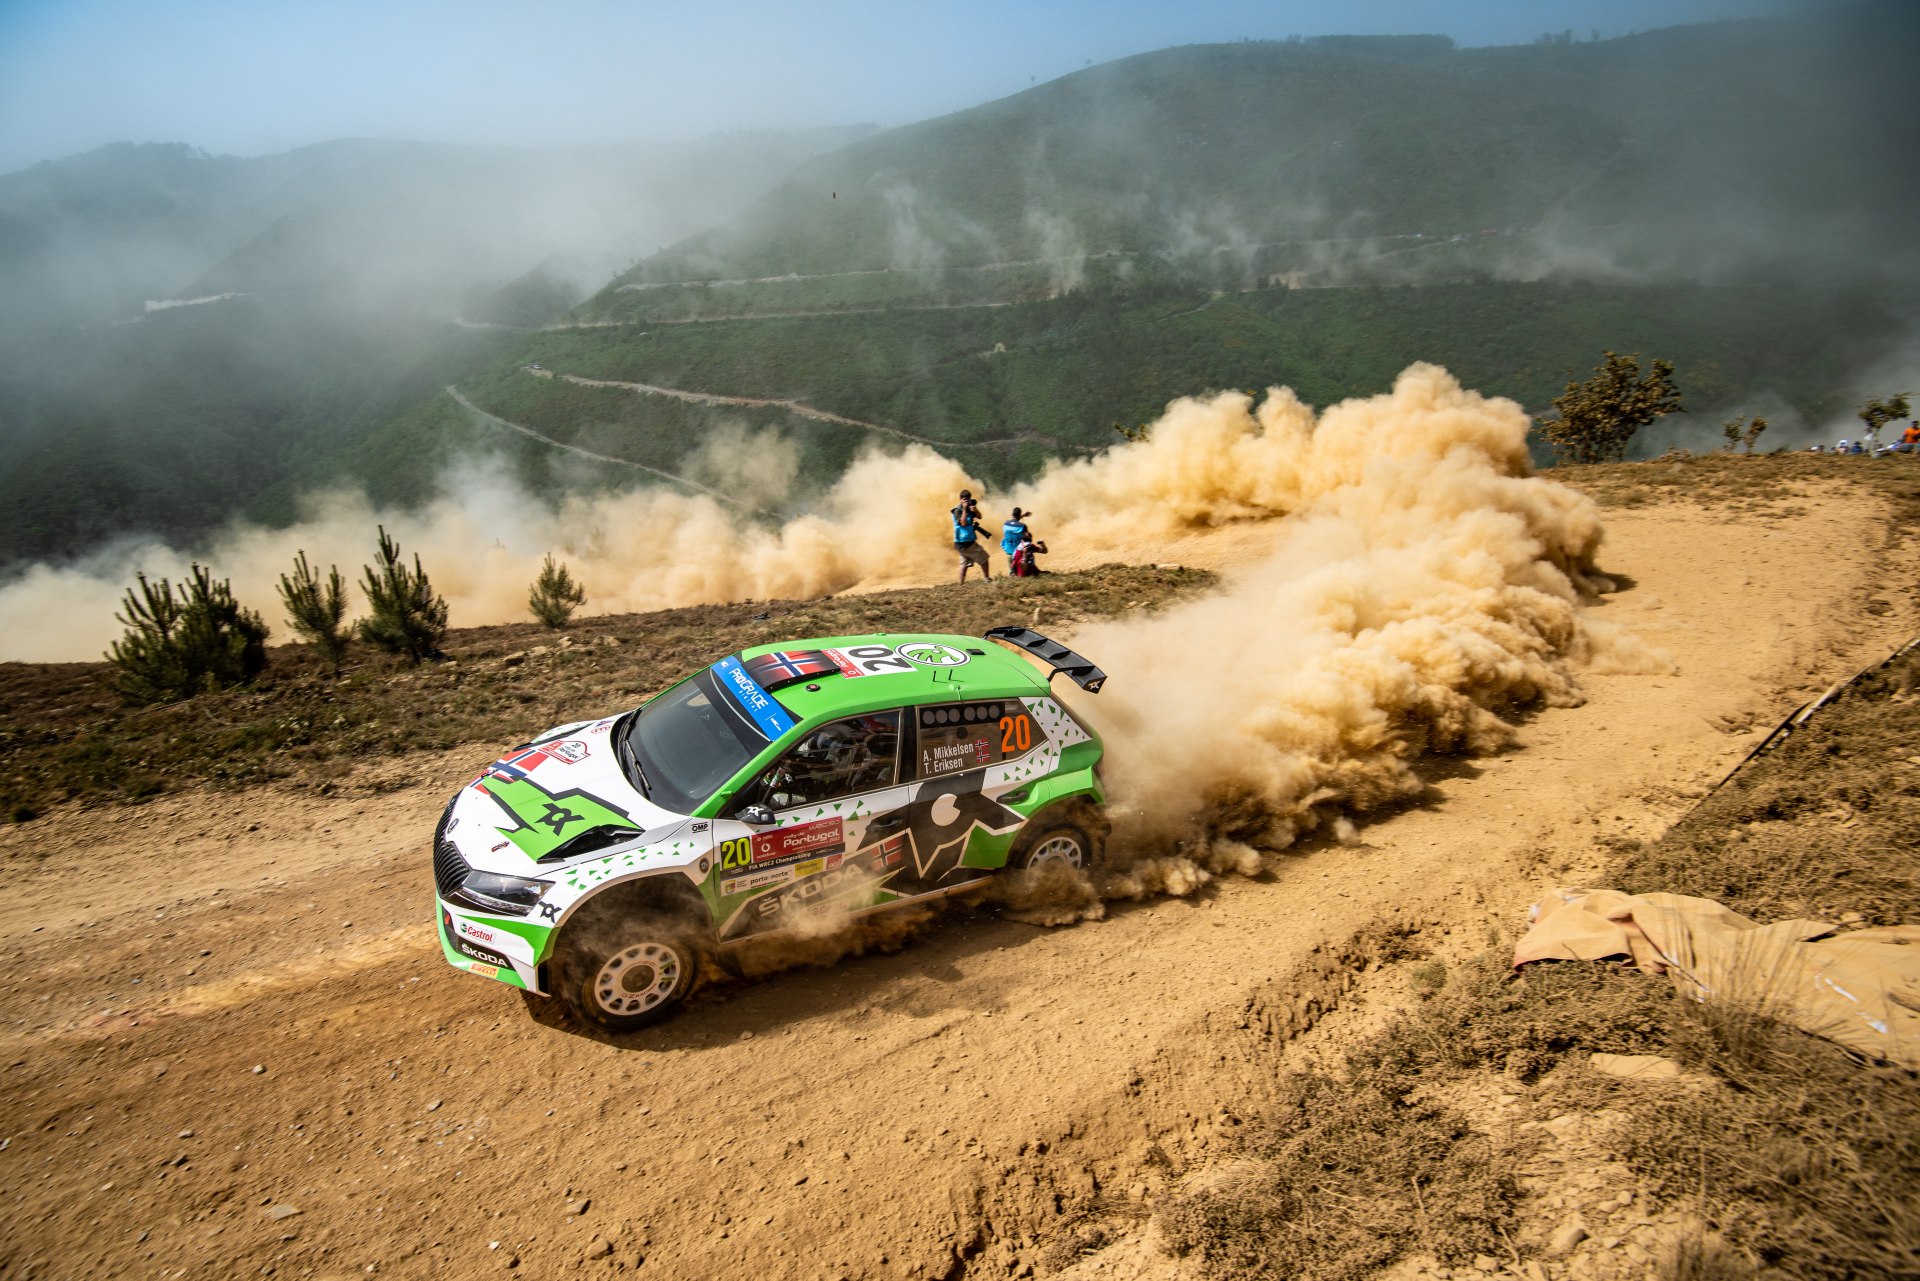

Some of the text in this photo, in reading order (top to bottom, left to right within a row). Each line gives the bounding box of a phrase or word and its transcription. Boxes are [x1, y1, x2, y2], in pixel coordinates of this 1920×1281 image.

[738, 690, 758, 712] DIGITAL
[999, 714, 1031, 753] 20
[923, 743, 974, 762] A. Mikkelsen
[923, 758, 964, 775] T. Eriksen
[691, 823, 708, 832] OMP
[783, 828, 840, 849] Portugal
[721, 837, 751, 869] 20
[758, 860, 775, 868] WRC2
[775, 852, 812, 864] Championship
[750, 876, 768, 885] porto
[770, 870, 789, 879] norte
[758, 863, 864, 917] ŠKODA
[467, 926, 494, 942] Castrol
[470, 963, 497, 976] PIRELLI
